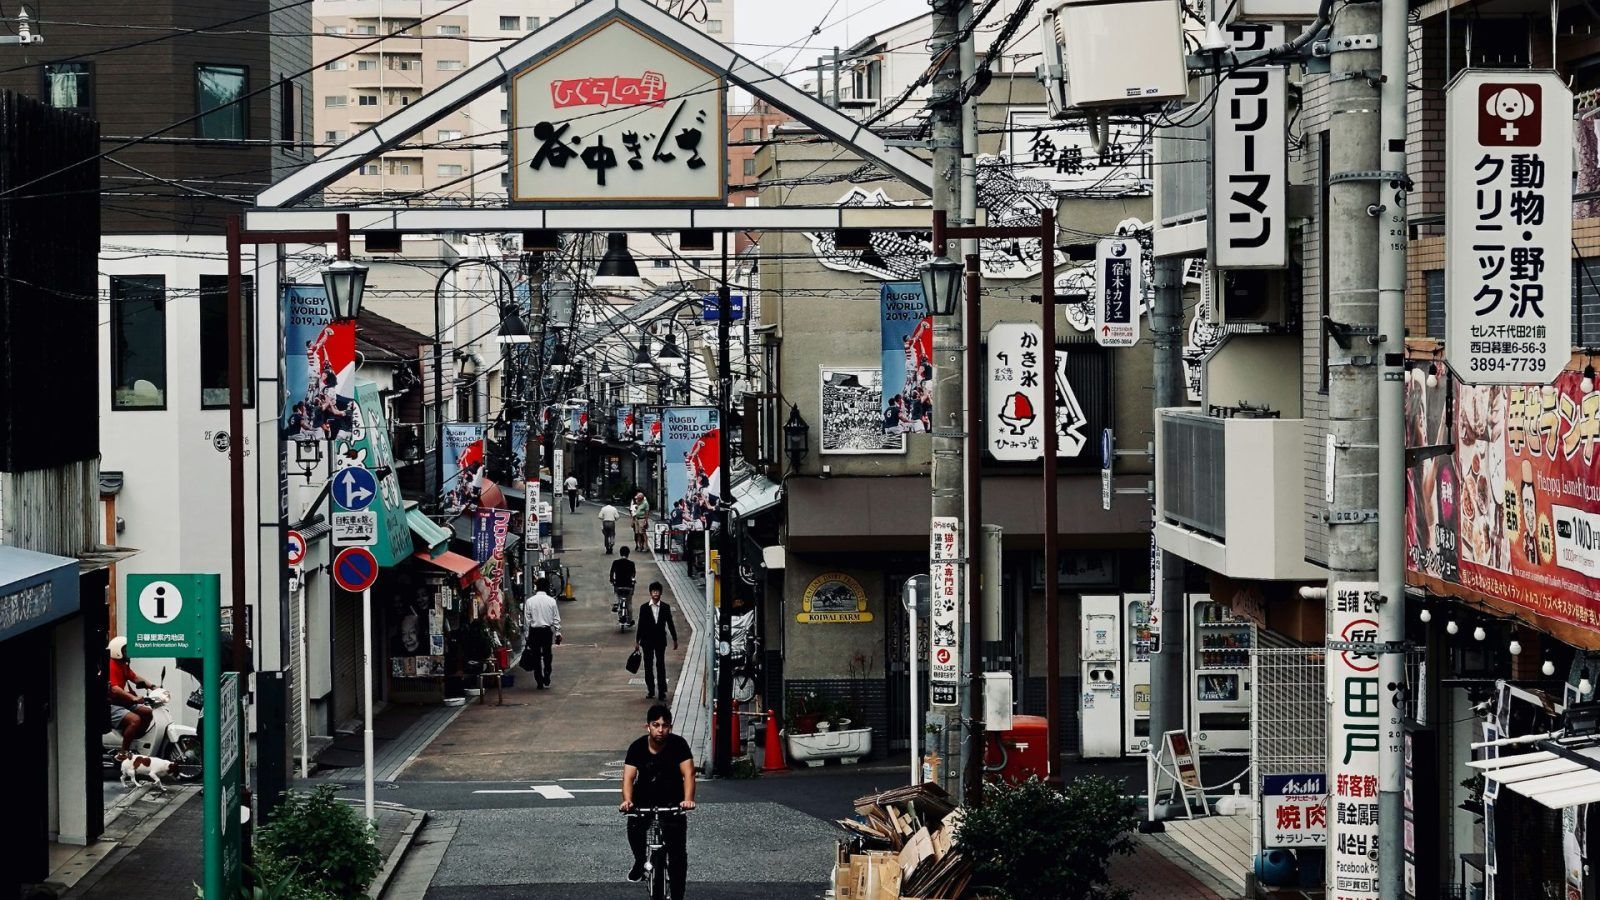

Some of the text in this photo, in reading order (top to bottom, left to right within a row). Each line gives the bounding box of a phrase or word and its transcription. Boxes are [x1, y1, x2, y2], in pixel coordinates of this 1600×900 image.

[551, 71, 665, 107] ひぐらしの里
[529, 99, 706, 186] 谷中ぎんざ
[1472, 153, 1506, 317] クリニック
[1509, 153, 1545, 318] 動物・野沢
[886, 292, 921, 301] RUGBY
[1112, 262, 1124, 319] 宿木カフェ
[291, 297, 326, 305] RUGBY
[886, 302, 924, 311] WORLD
[291, 307, 328, 316] WORLD
[886, 312, 911, 321] 2019,
[291, 317, 315, 326] 2019,
[1470, 325, 1546, 339] セレス千代田21前
[1470, 341, 1546, 355] 西日暮里6-56-3
[1020, 331, 1038, 388] かき氷
[1470, 358, 1546, 372] 3894-7739
[669, 416, 697, 424] RUGBY
[691, 433, 717, 441] JAPAN
[994, 436, 1039, 450] ひみつ堂
[1537, 470, 1561, 499] Happy
[1561, 473, 1582, 497] Lunch
[336, 516, 373, 525] 自転車を除く
[336, 526, 373, 534] 一方通行
[136, 633, 185, 641] 日暮里案内地図
[1136, 693, 1151, 702] FIR
[1343, 677, 1379, 765] 田戸
[1282, 778, 1320, 794] Asahi
[1337, 773, 1380, 798] 新客歓
[1276, 804, 1326, 830] 焼肉
[1276, 833, 1326, 843] サラリーマン
[1337, 833, 1367, 856] 새손님
[1337, 860, 1369, 874] Facebook
